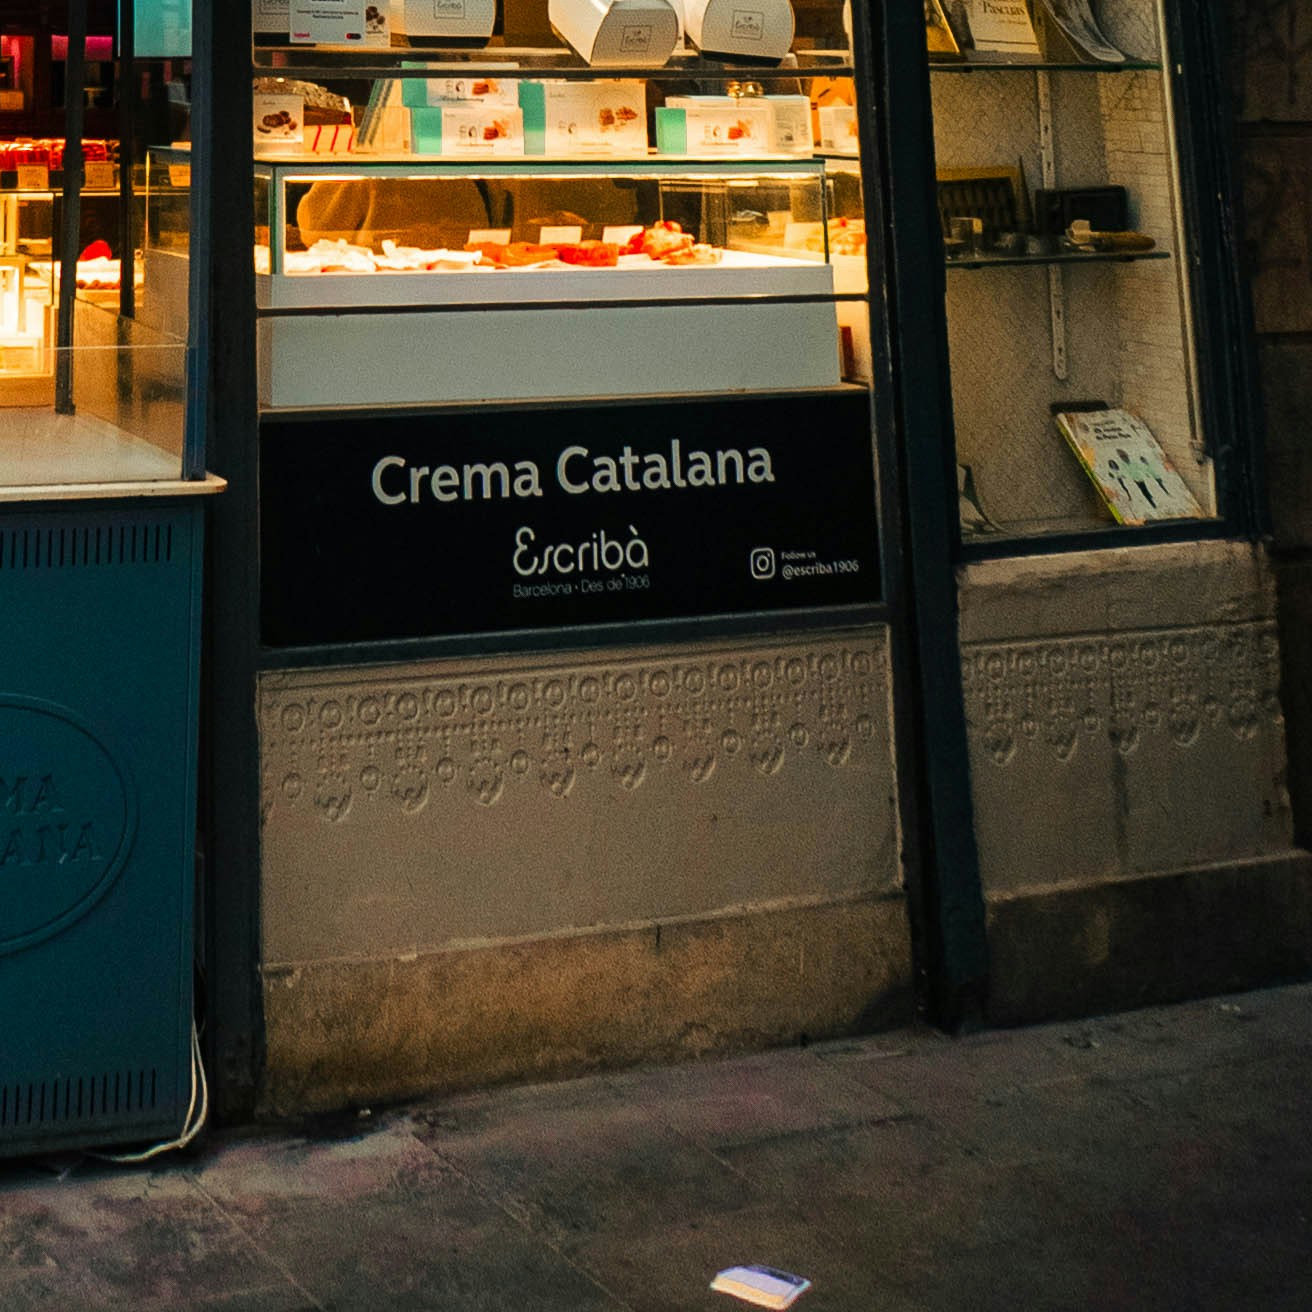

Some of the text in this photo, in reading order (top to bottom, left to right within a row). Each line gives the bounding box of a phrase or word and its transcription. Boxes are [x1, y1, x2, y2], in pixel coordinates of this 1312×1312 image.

[371, 438, 776, 505] Crema Catalana
[513, 524, 649, 576] Escribà
[513, 575, 650, 599] Barcelona Des de 1906
[782, 559, 860, 580] @escriba1906
